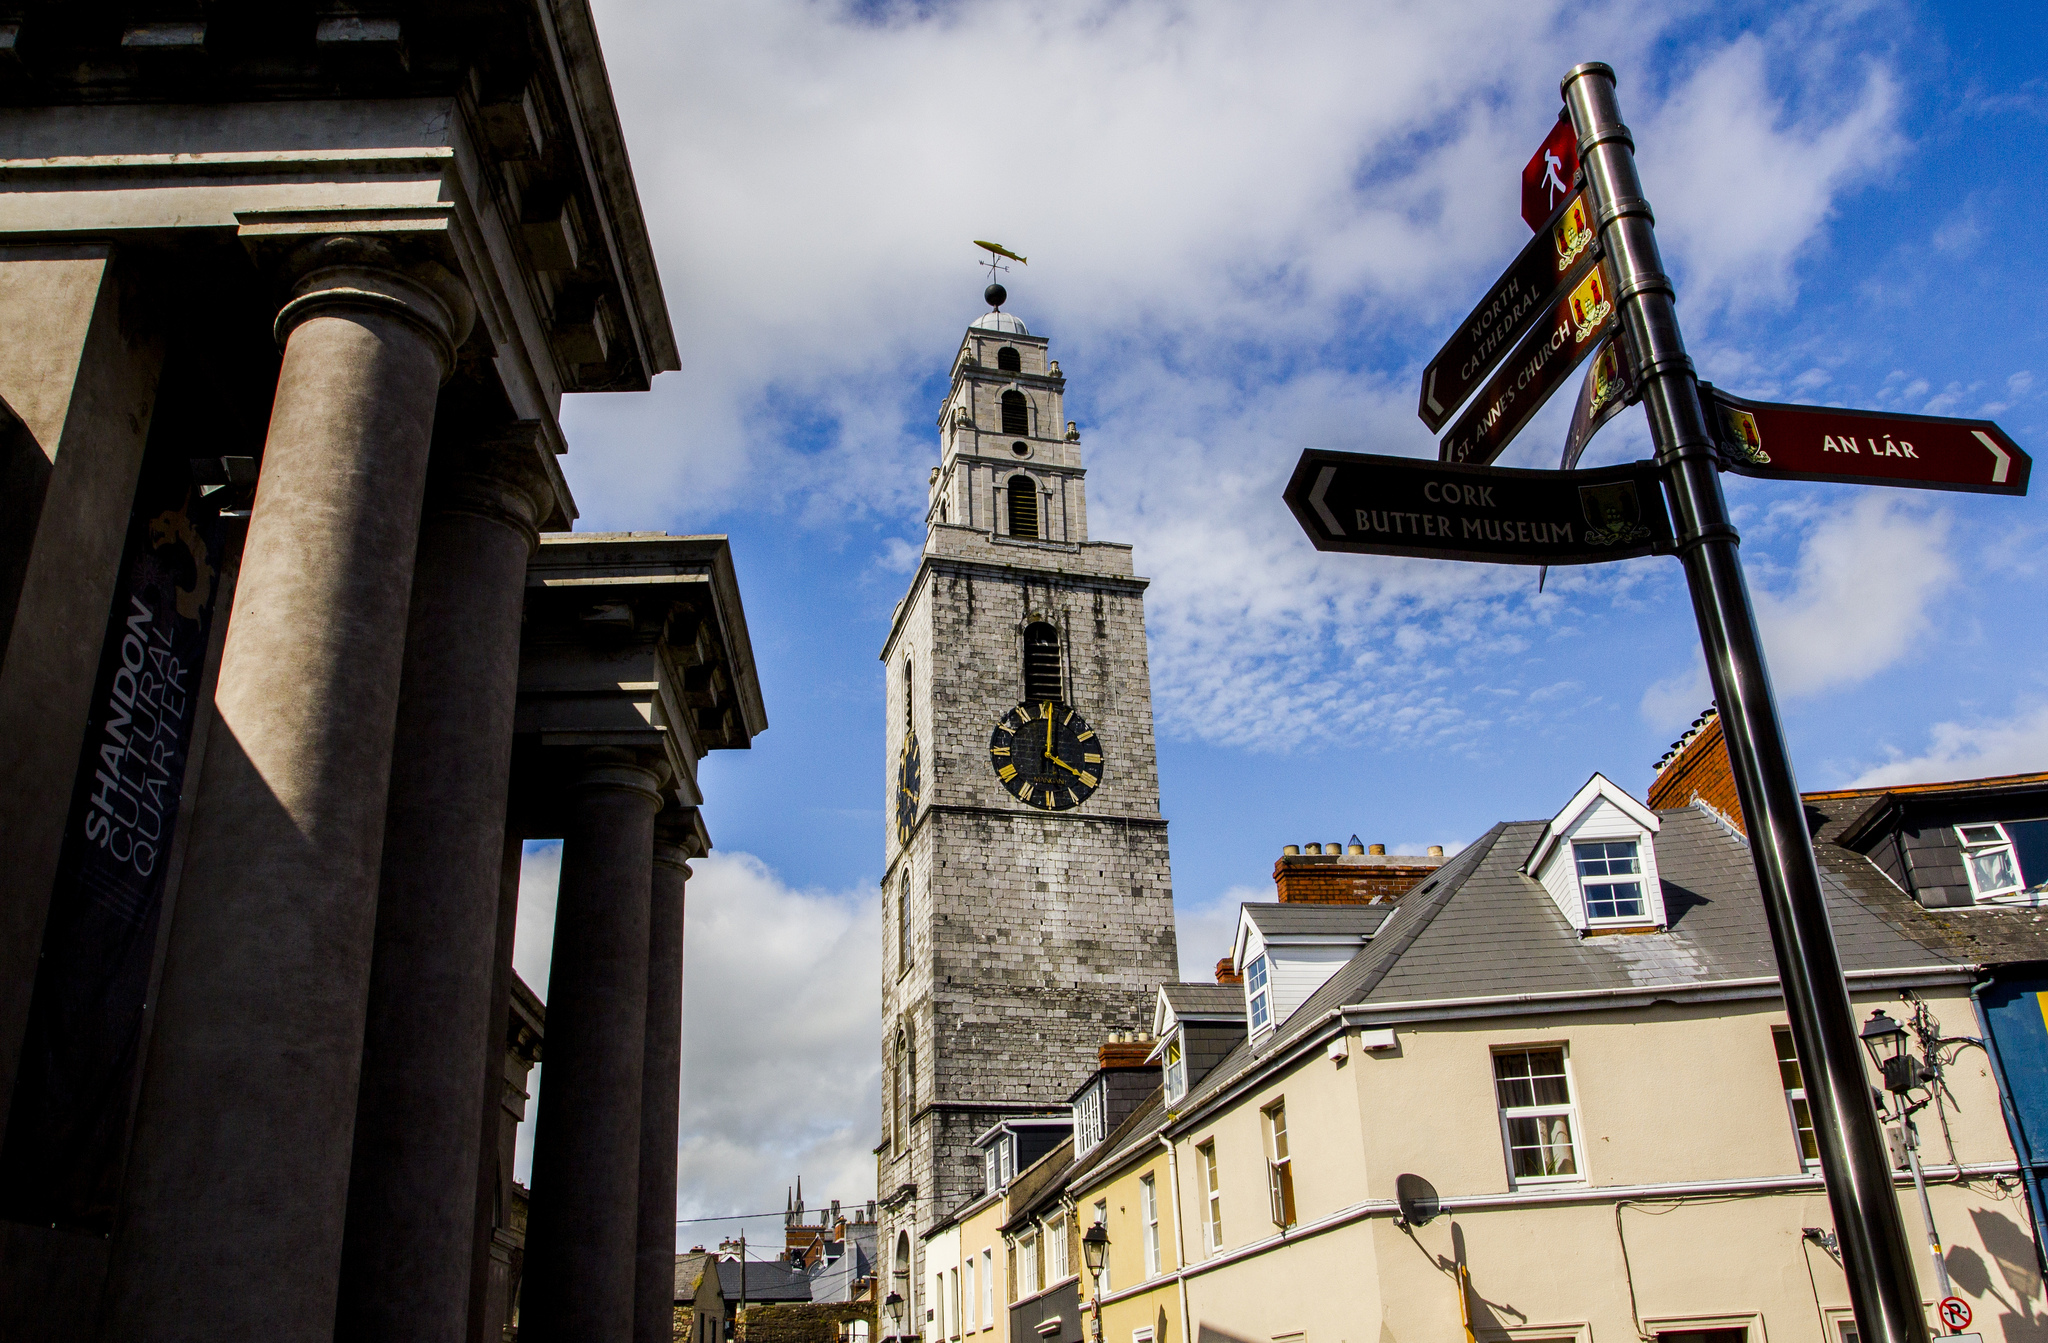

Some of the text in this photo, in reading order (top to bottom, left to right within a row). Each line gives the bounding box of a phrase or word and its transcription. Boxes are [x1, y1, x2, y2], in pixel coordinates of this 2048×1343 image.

[1461, 284, 1540, 381] CATHEDRAL
[1471, 277, 1519, 342] NORTH
[1457, 319, 1571, 463] ST. ANNE'S CHURCH
[1423, 481, 1497, 508] CORK
[1823, 434, 1920, 459] AN LÁR
[1355, 509, 1574, 543] BUTTER MUSEUM
[85, 596, 154, 848] SHANDON
[110, 627, 175, 863] CULTURAL
[133, 656, 189, 878] QUARTER
